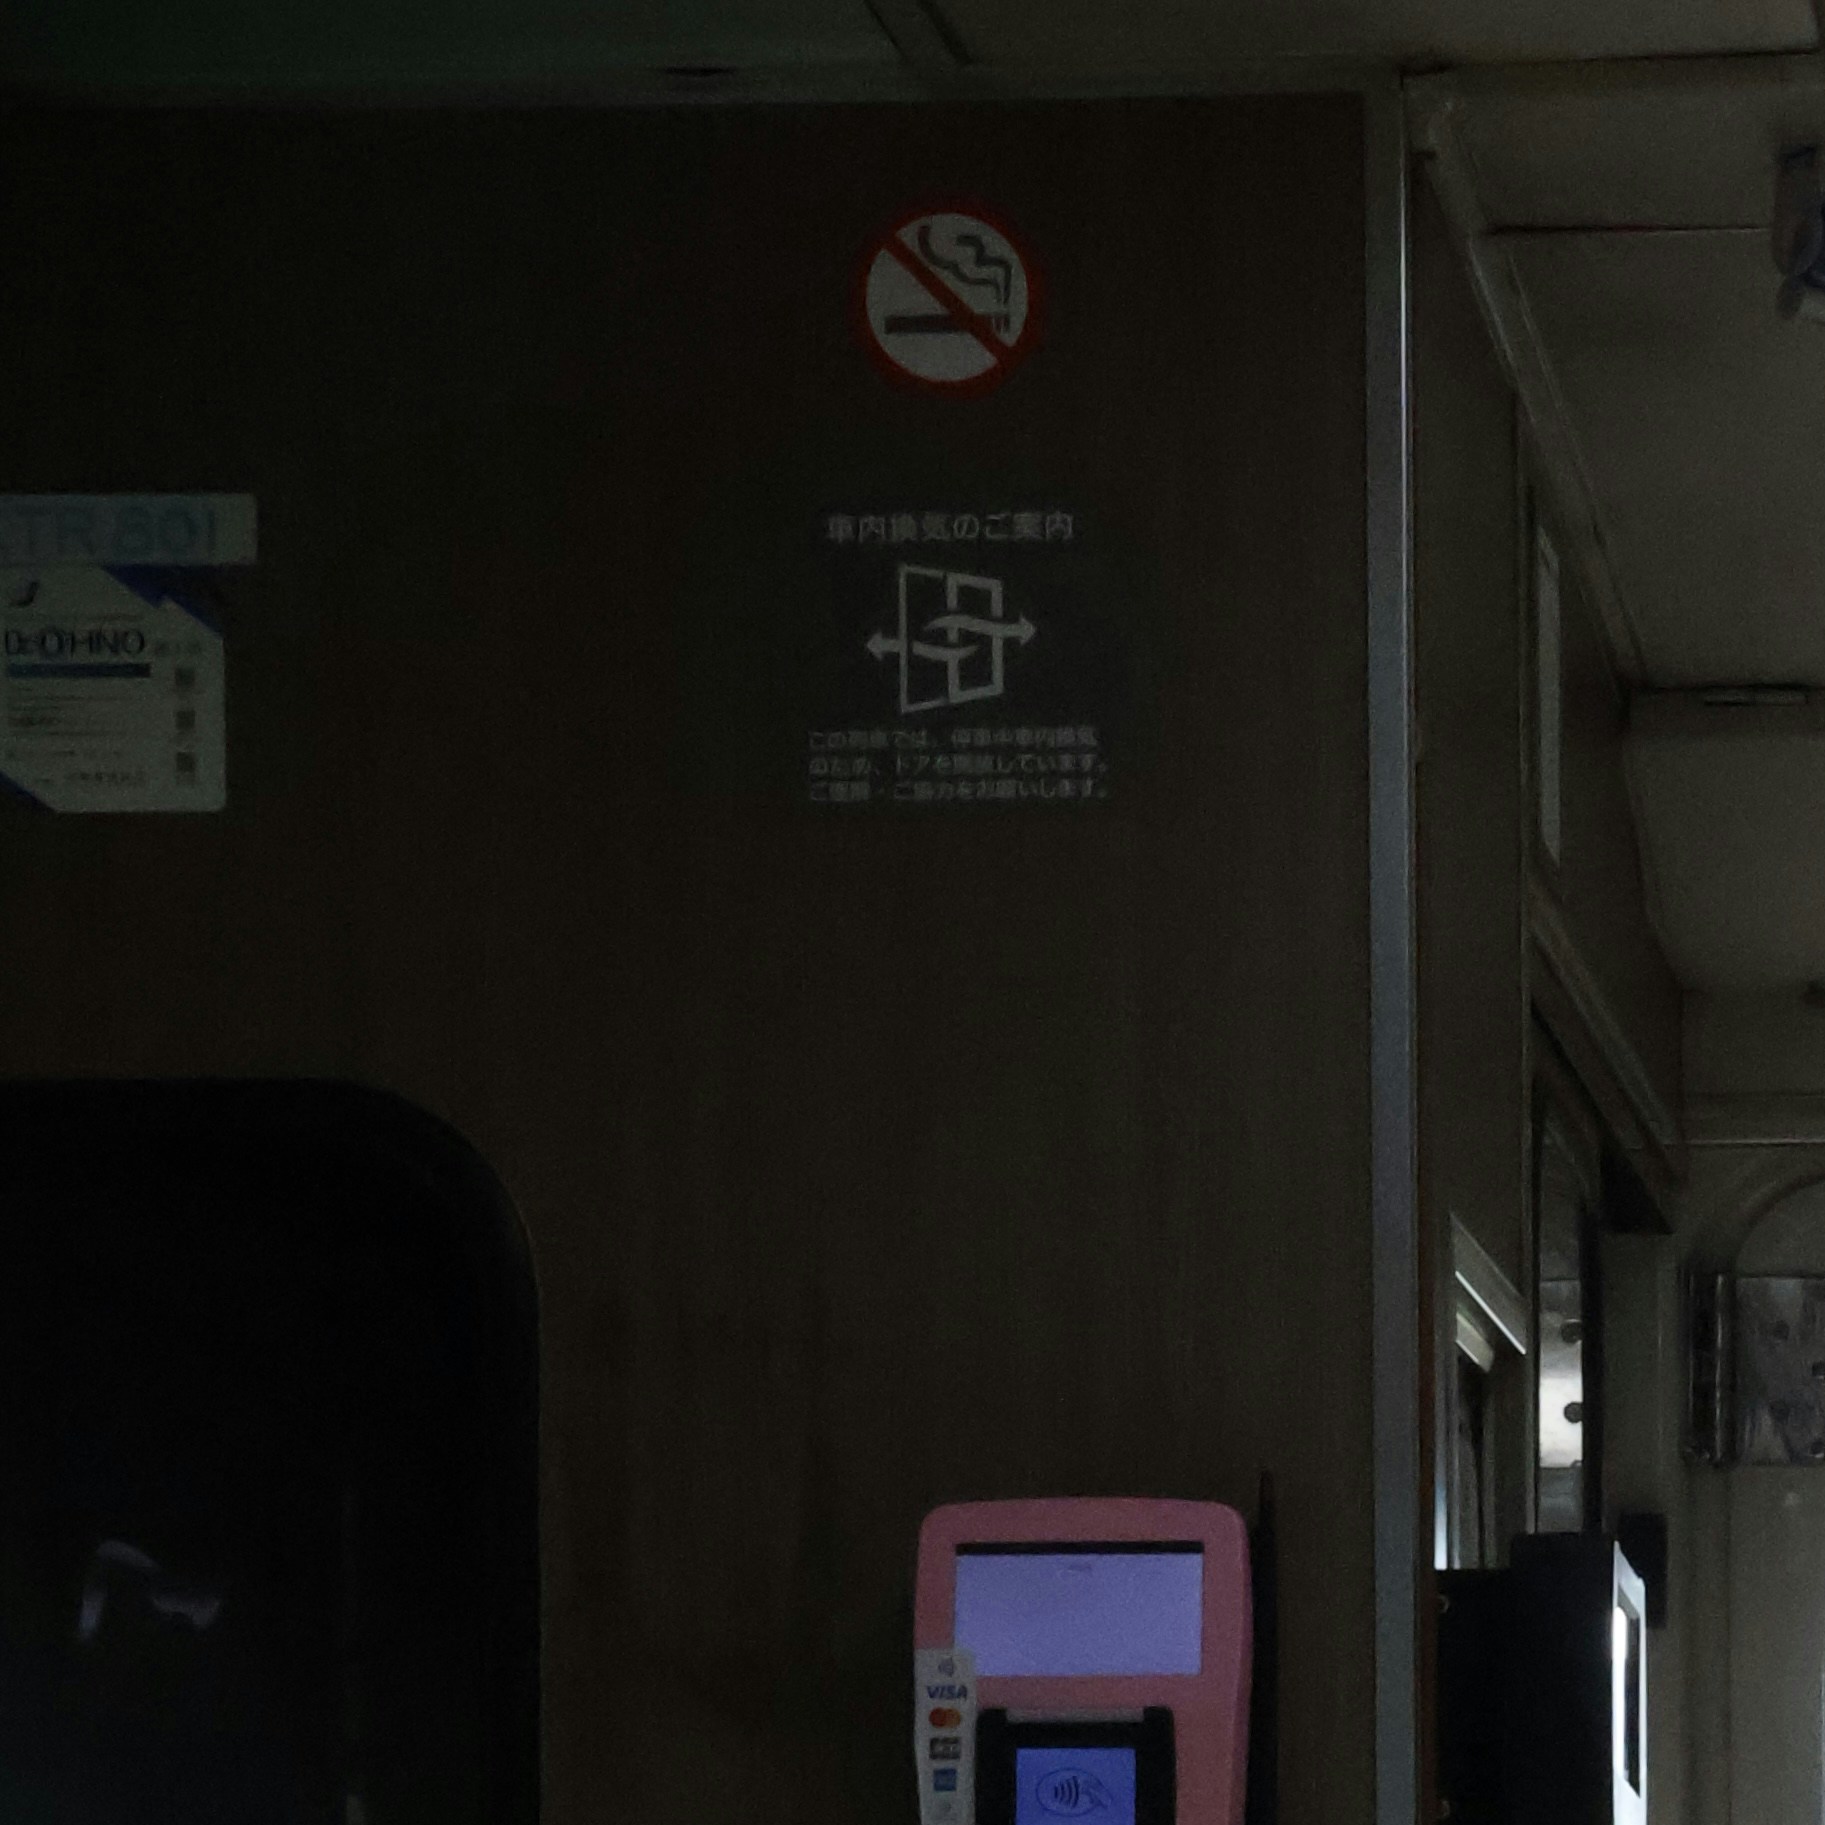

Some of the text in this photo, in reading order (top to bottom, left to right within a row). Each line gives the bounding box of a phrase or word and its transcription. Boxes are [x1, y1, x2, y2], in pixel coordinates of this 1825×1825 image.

[0, 504, 96, 555] TR
[826, 510, 1076, 543] 車内換気のご案内
[926, 1685, 968, 1700] VISA
